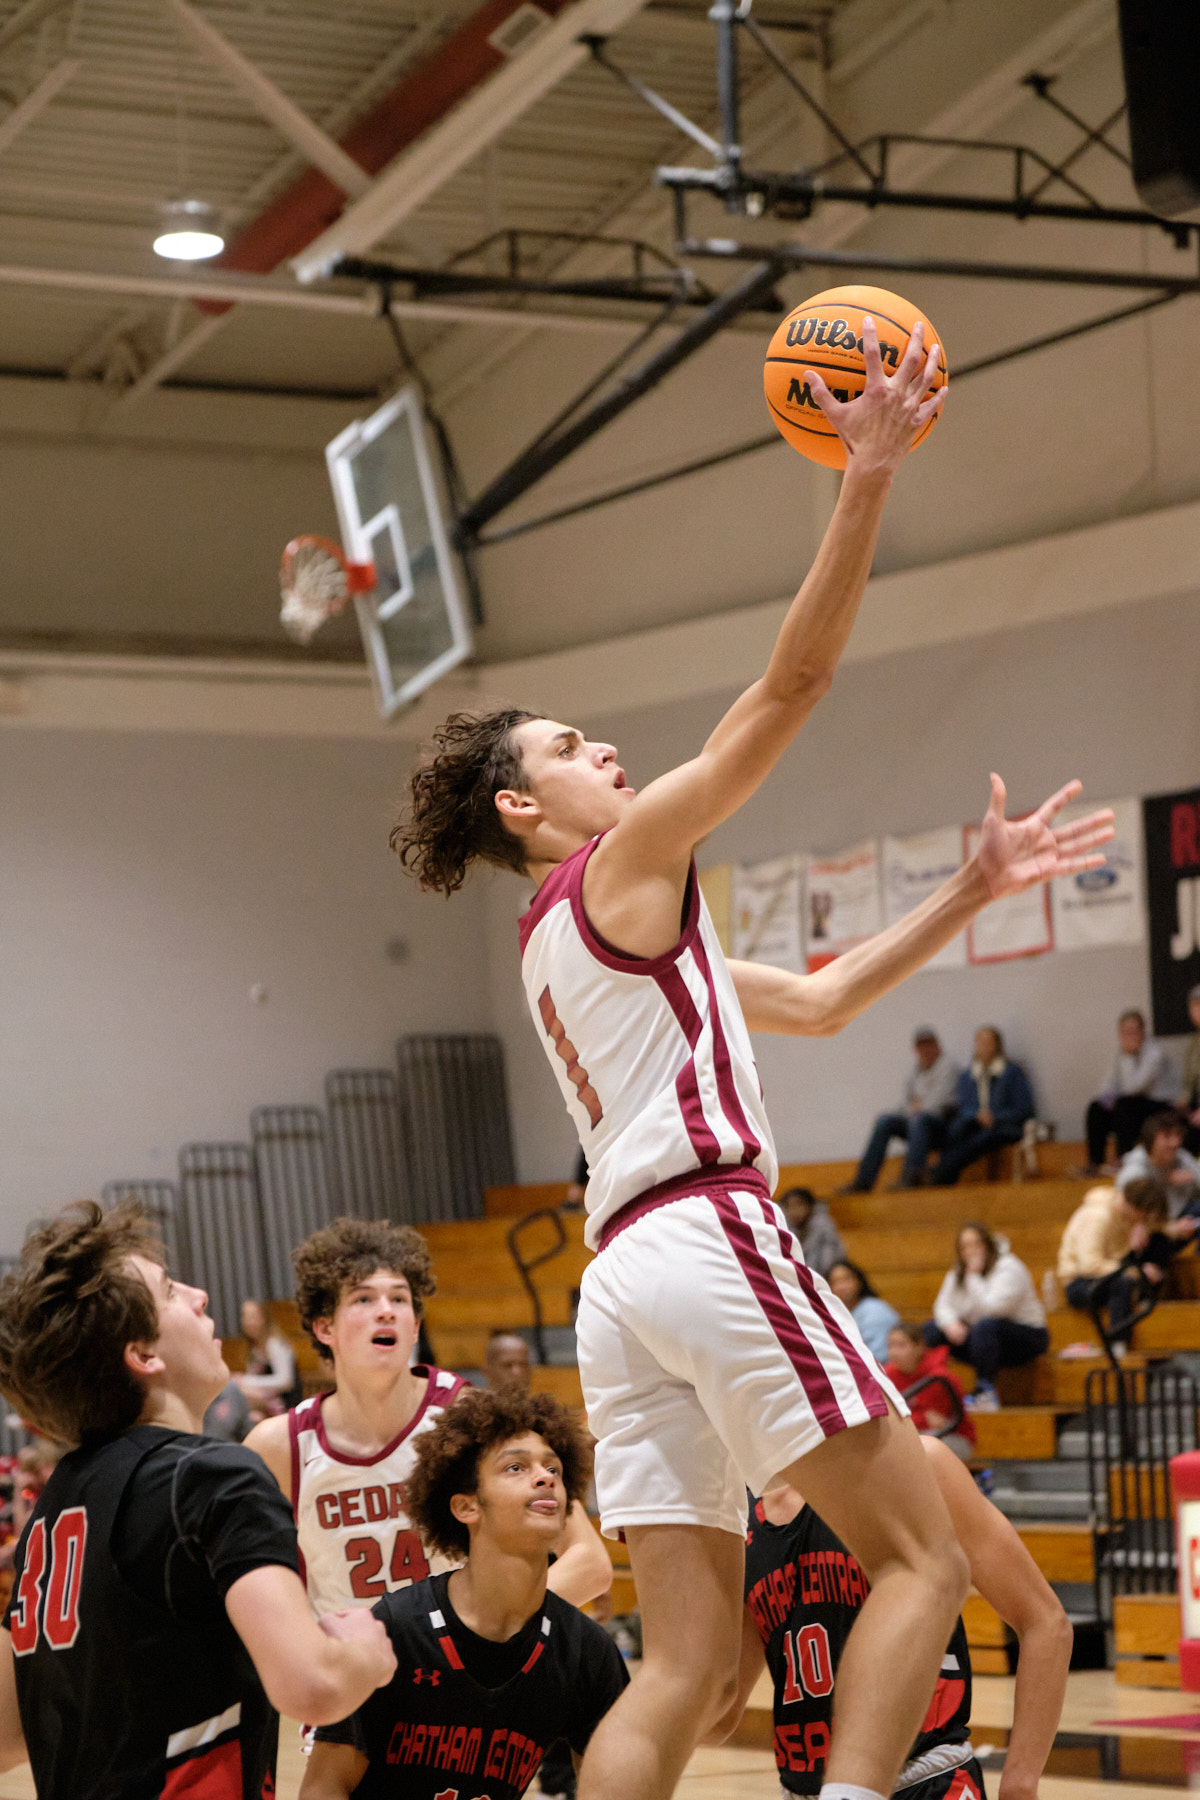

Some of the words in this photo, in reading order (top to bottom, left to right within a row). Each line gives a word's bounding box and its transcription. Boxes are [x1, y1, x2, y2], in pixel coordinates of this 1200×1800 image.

[538, 982, 604, 1132] 1
[315, 1482, 412, 1530] CEDA
[10, 1506, 87, 1657] 30
[344, 1529, 432, 1599] 24
[782, 1622, 835, 1706] 10
[386, 1721, 483, 1776] CHATHAM
